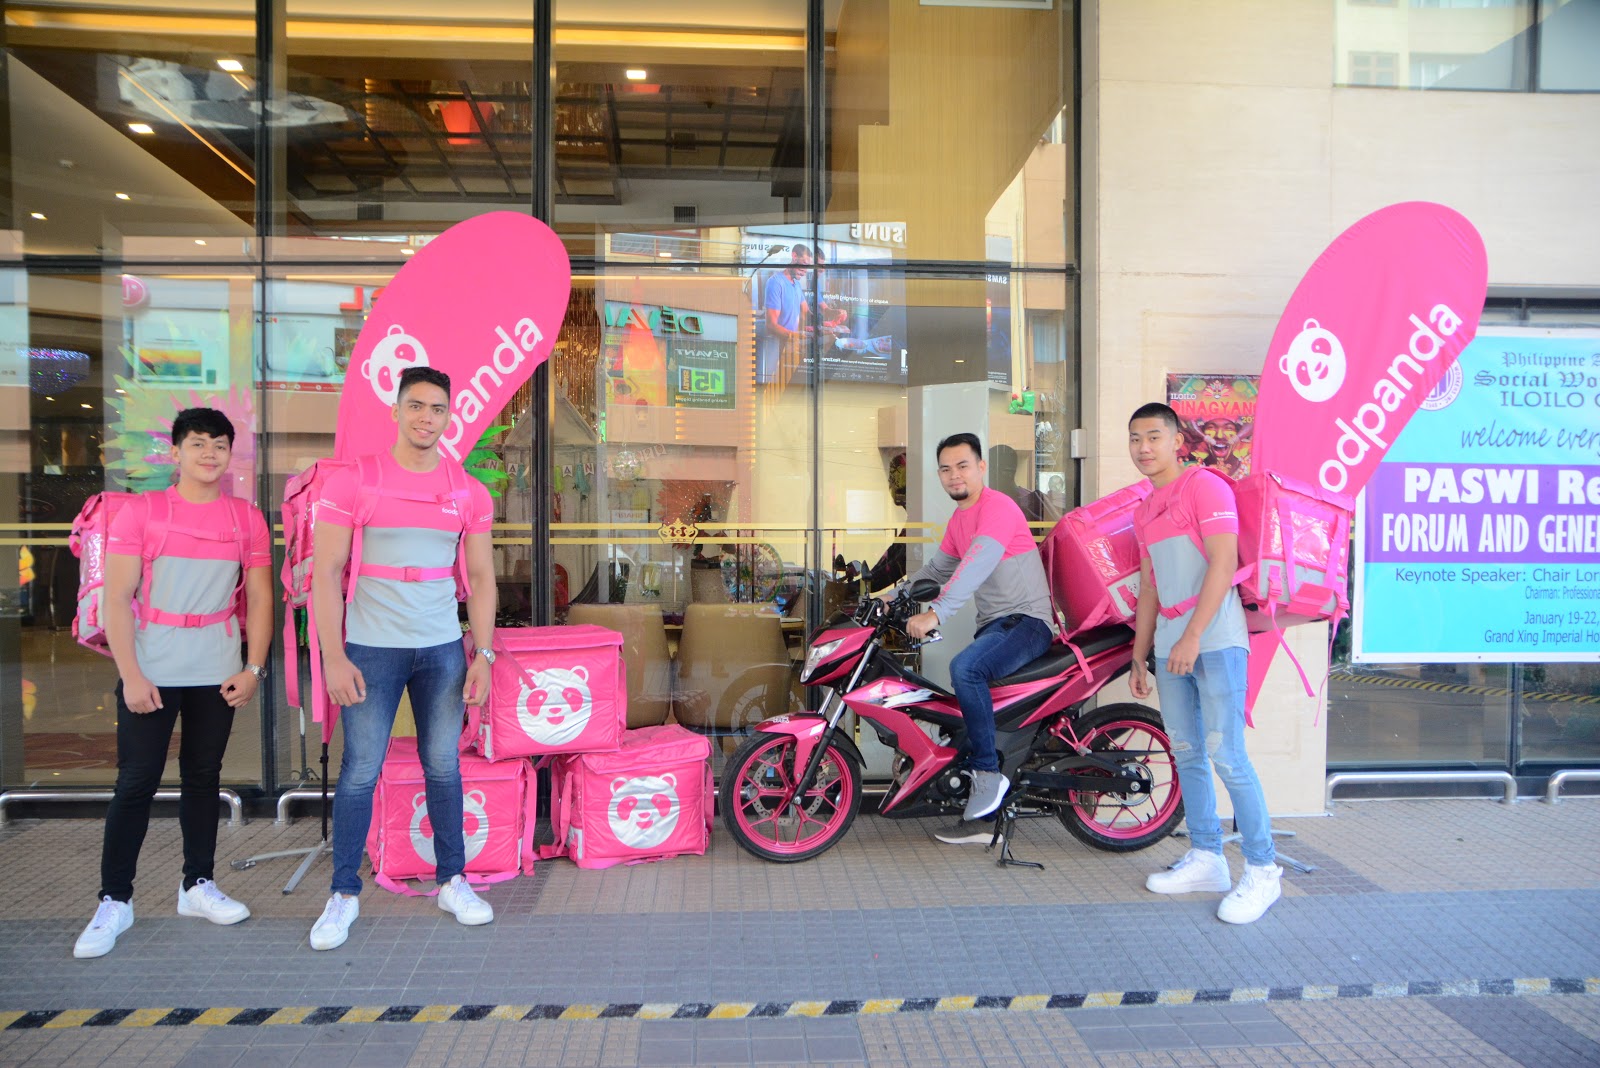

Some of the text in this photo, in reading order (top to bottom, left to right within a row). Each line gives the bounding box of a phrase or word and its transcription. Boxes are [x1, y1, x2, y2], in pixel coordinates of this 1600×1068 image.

[1502, 352, 1585, 367] Philippine
[1474, 371, 1600, 388] Social Wo
[437, 317, 544, 462] panda
[1501, 391, 1584, 408] ILOILO
[1461, 419, 1552, 448] welcome
[1405, 467, 1600, 505] PASWI Re
[1382, 513, 1600, 553] FORUM AND GENE
[1395, 568, 1456, 584] Keynote
[1461, 568, 1527, 584] Speaker:
[1532, 568, 1571, 582] Chair
[1525, 586, 1561, 600] Chairman:
[1524, 611, 1600, 626] January 19-22,
[1484, 630, 1514, 643] Grand
[1517, 630, 1539, 646] Xing
[1542, 630, 1583, 645] Imperial
